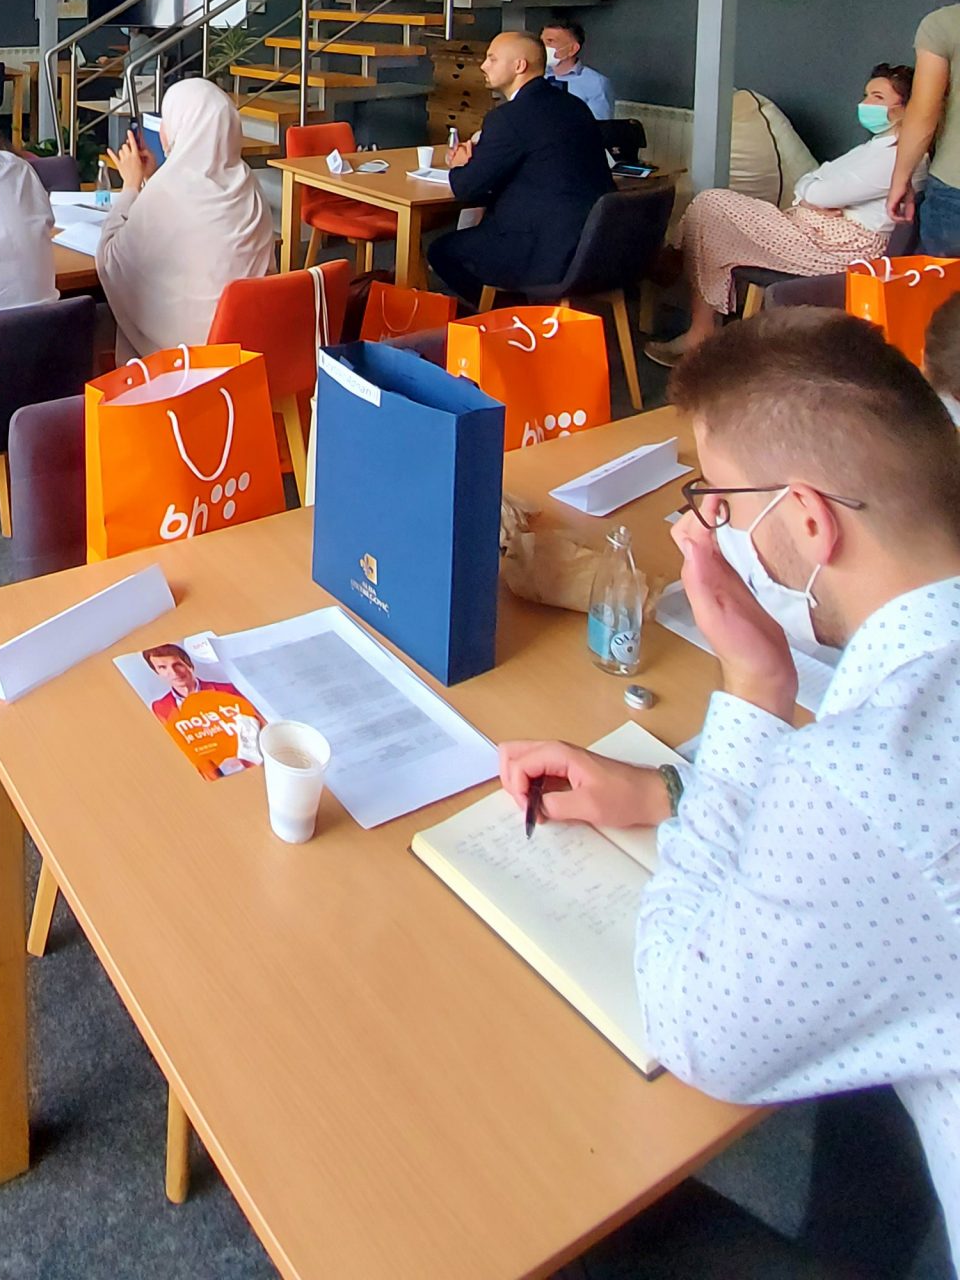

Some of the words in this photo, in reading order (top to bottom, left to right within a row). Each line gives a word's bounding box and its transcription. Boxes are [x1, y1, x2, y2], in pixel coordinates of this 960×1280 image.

[160, 495, 209, 540] bh
[175, 709, 220, 732] moja
[218, 703, 241, 718] tv
[185, 730, 195, 744] je
[195, 724, 224, 740] uvijek
